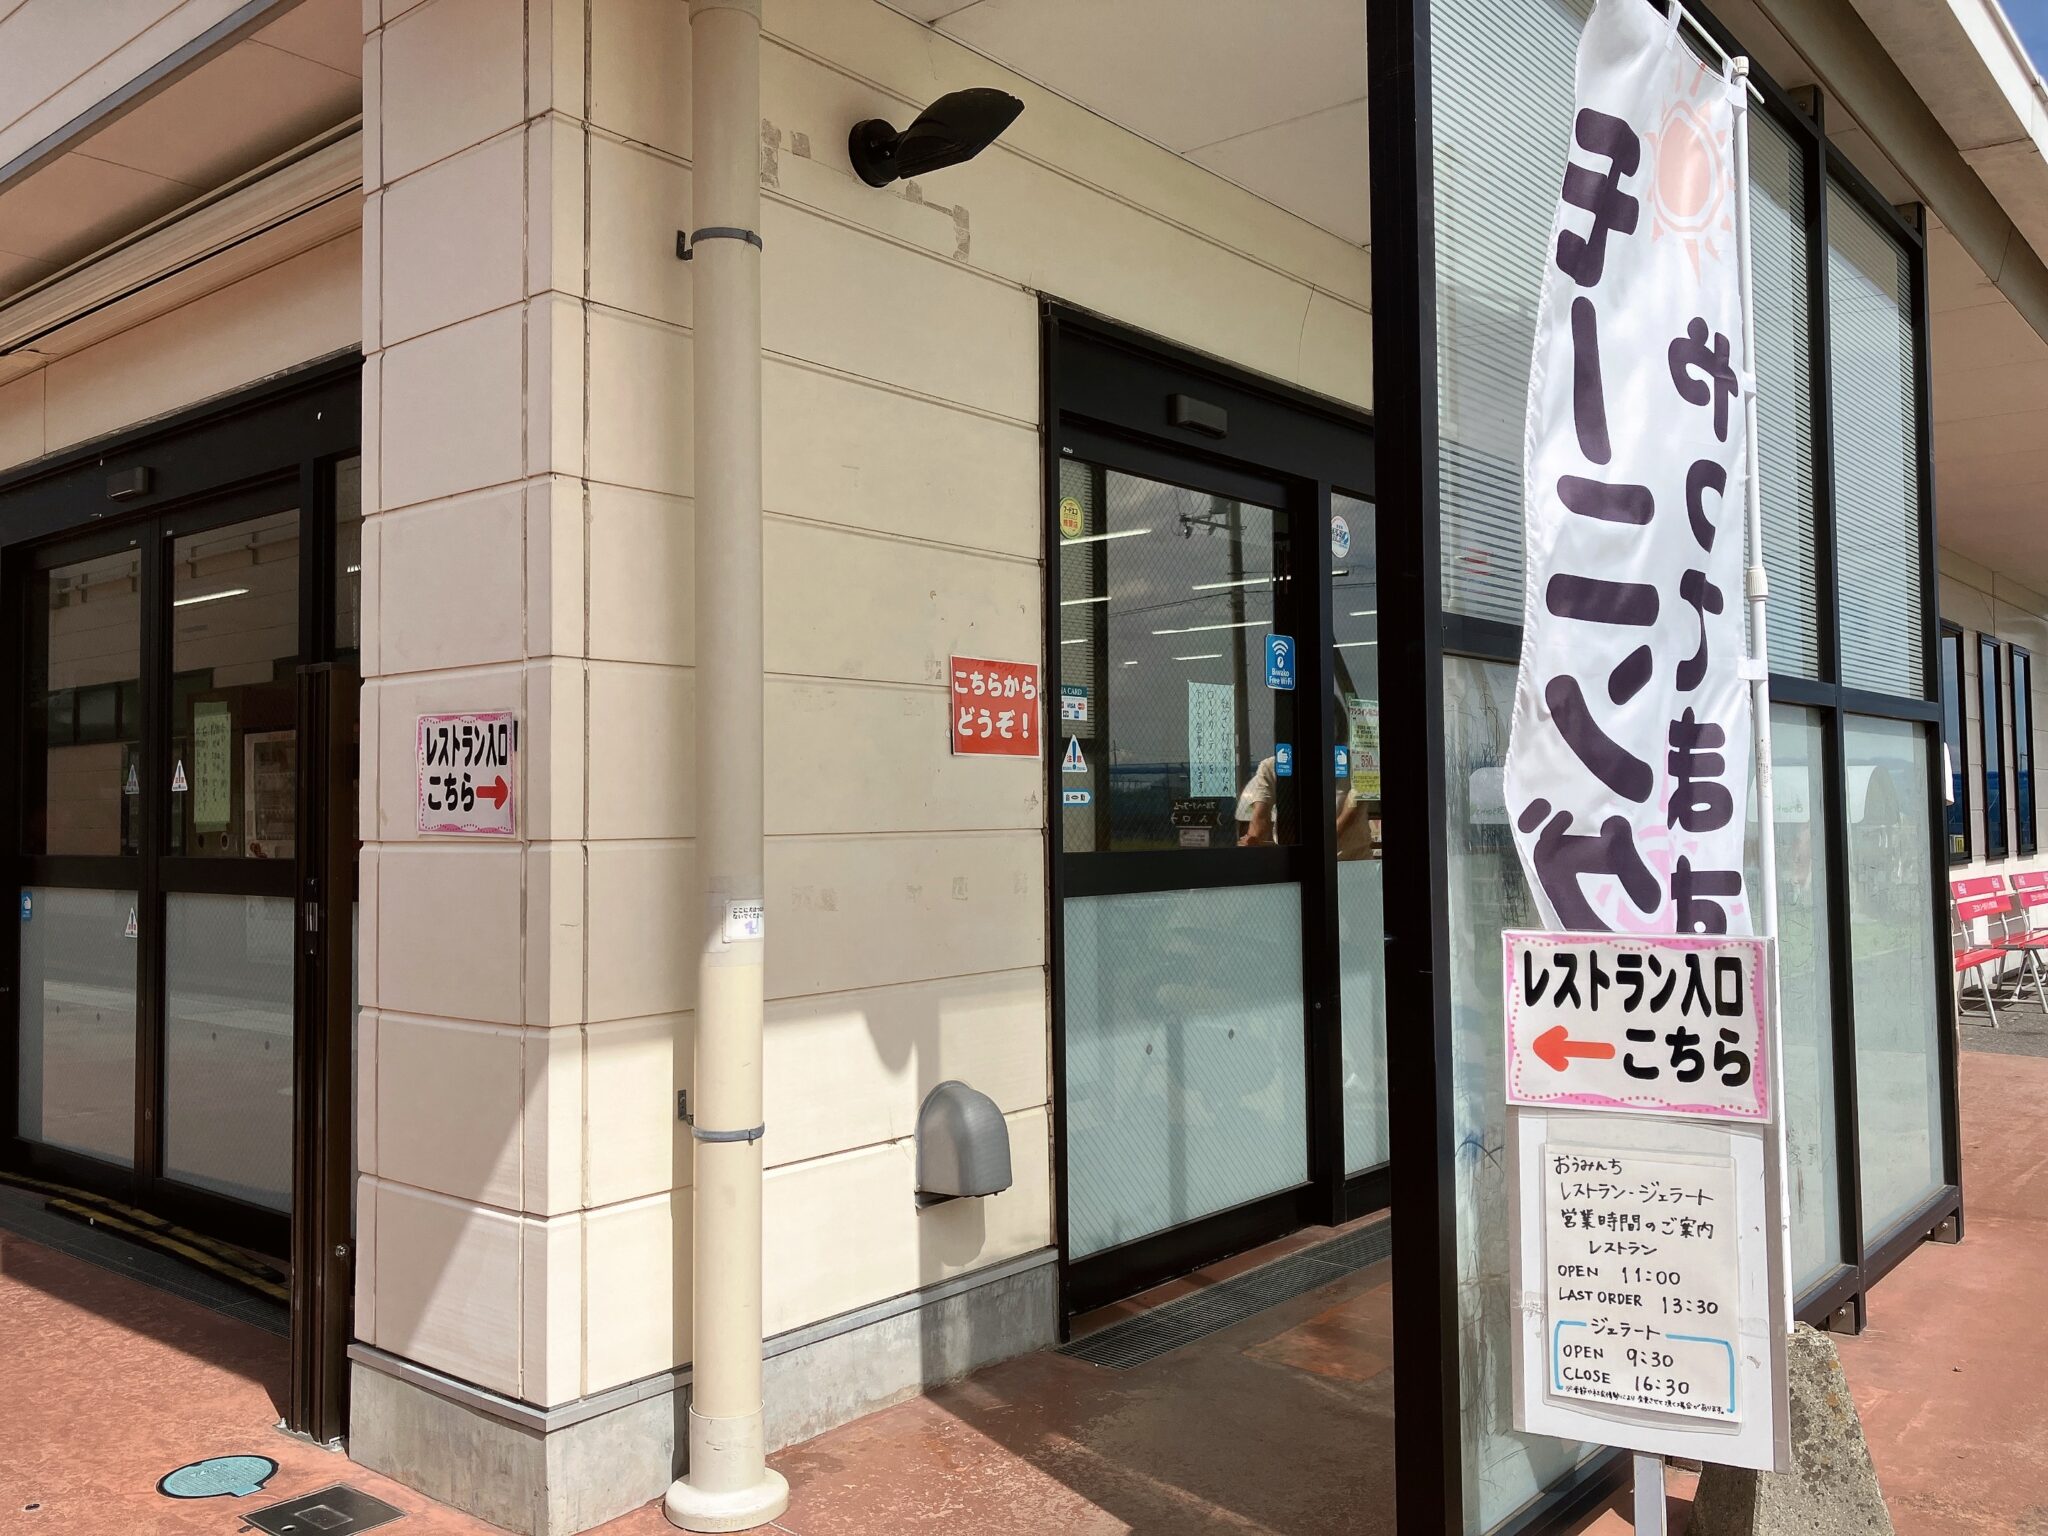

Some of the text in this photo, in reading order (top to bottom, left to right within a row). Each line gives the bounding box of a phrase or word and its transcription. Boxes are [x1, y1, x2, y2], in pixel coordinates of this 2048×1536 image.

[954, 670, 1037, 700] こちらから
[957, 706, 1029, 739] どうぞ！
[426, 723, 508, 767] レストラン入口
[427, 772, 475, 812] こちら
[1524, 950, 1744, 1017] レストラン入口
[1623, 1026, 1751, 1087] こちら
[1553, 1155, 1623, 1175] おうみんち
[1560, 1208, 1714, 1239] 営業時間のご案内
[1589, 1240, 1658, 1255] レストラン
[1557, 1264, 1681, 1285] OPEN 11:00
[1558, 1286, 1719, 1315] LAST ORDER 13:30
[1590, 1317, 1661, 1340] ジェラート
[1562, 1344, 1674, 1368] OPEN 9:30
[1562, 1366, 1690, 1397] CLOSE 16:30
